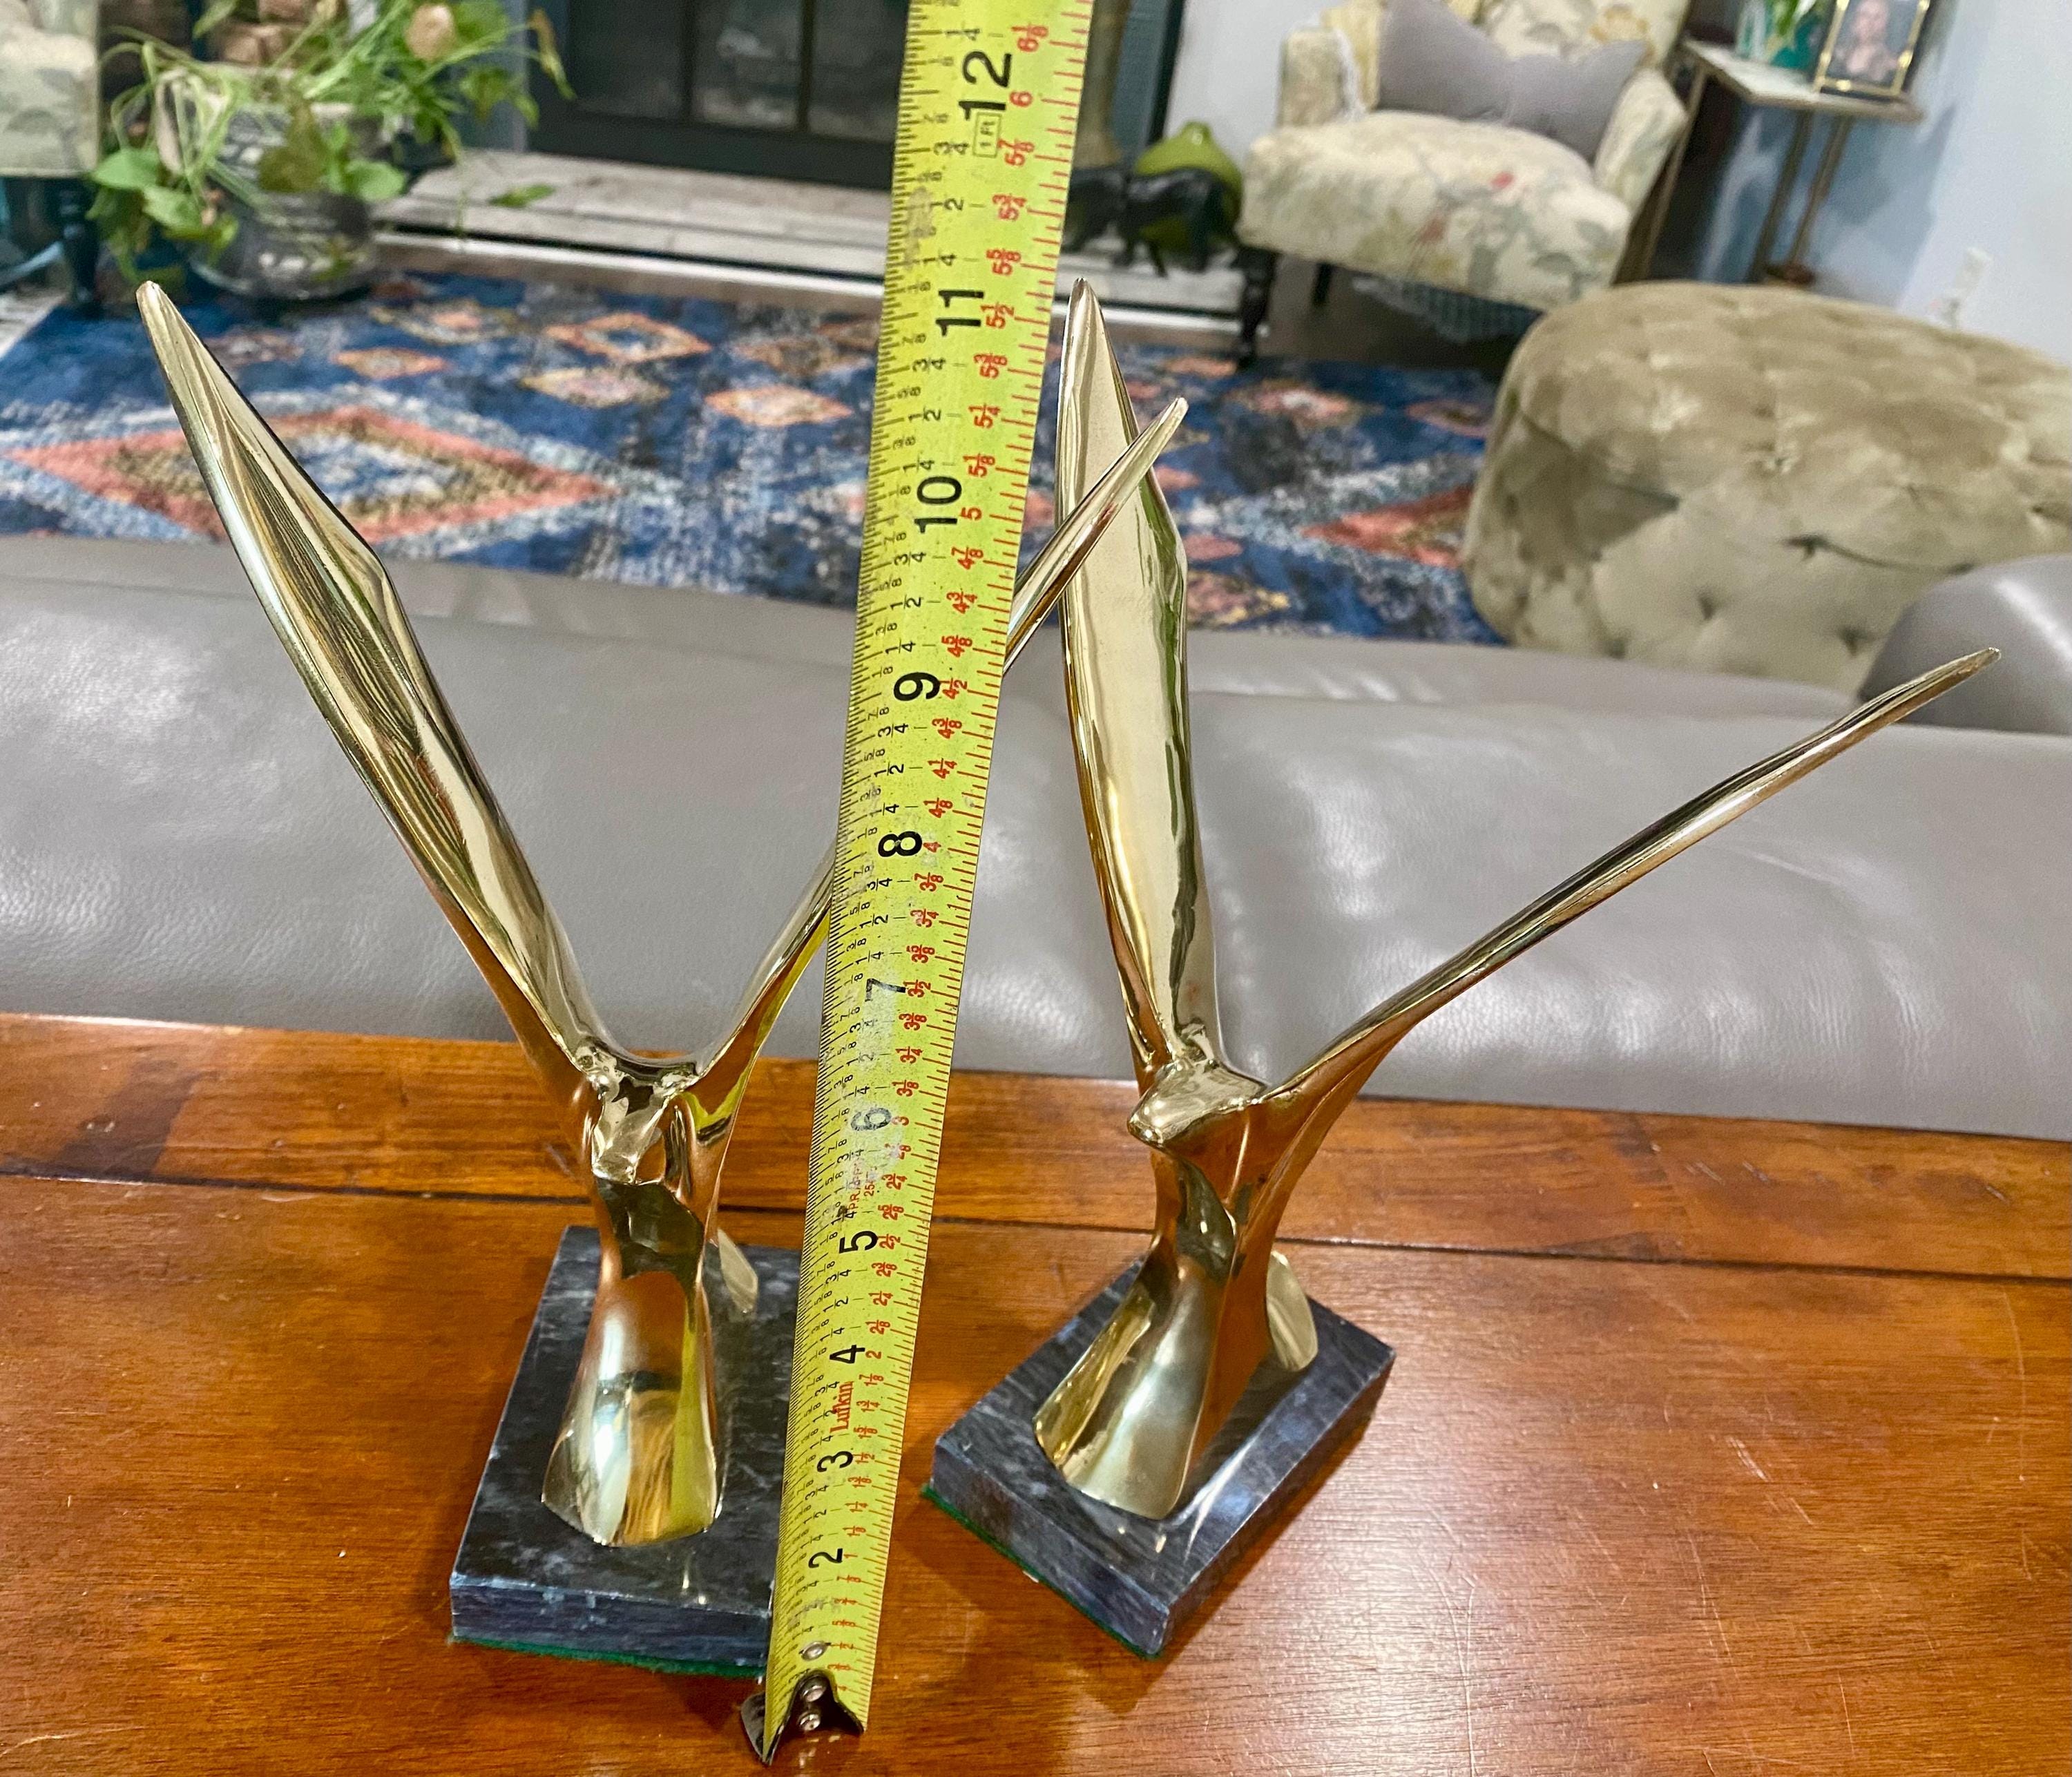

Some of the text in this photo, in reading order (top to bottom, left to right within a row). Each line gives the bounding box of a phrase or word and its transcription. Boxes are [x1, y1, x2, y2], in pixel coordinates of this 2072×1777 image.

[957, 50, 1012, 120] 12
[1008, 90, 1032, 107] 6
[935, 289, 984, 336] 11
[914, 477, 961, 534] 10
[959, 506, 981, 520] 5
[893, 672, 940, 702] 9
[878, 831, 922, 858] 8
[923, 841, 941, 852] 4
[865, 979, 905, 1001] 7
[851, 1107, 892, 1131] 6
[891, 1116, 909, 1126] 3
[838, 1230, 877, 1253] 5
[829, 1345, 865, 1364] 4
[866, 1350, 881, 1358] 2
[829, 1381, 854, 1433] Lufkin
[817, 1451, 853, 1472] 3
[808, 1548, 843, 1568] 2
